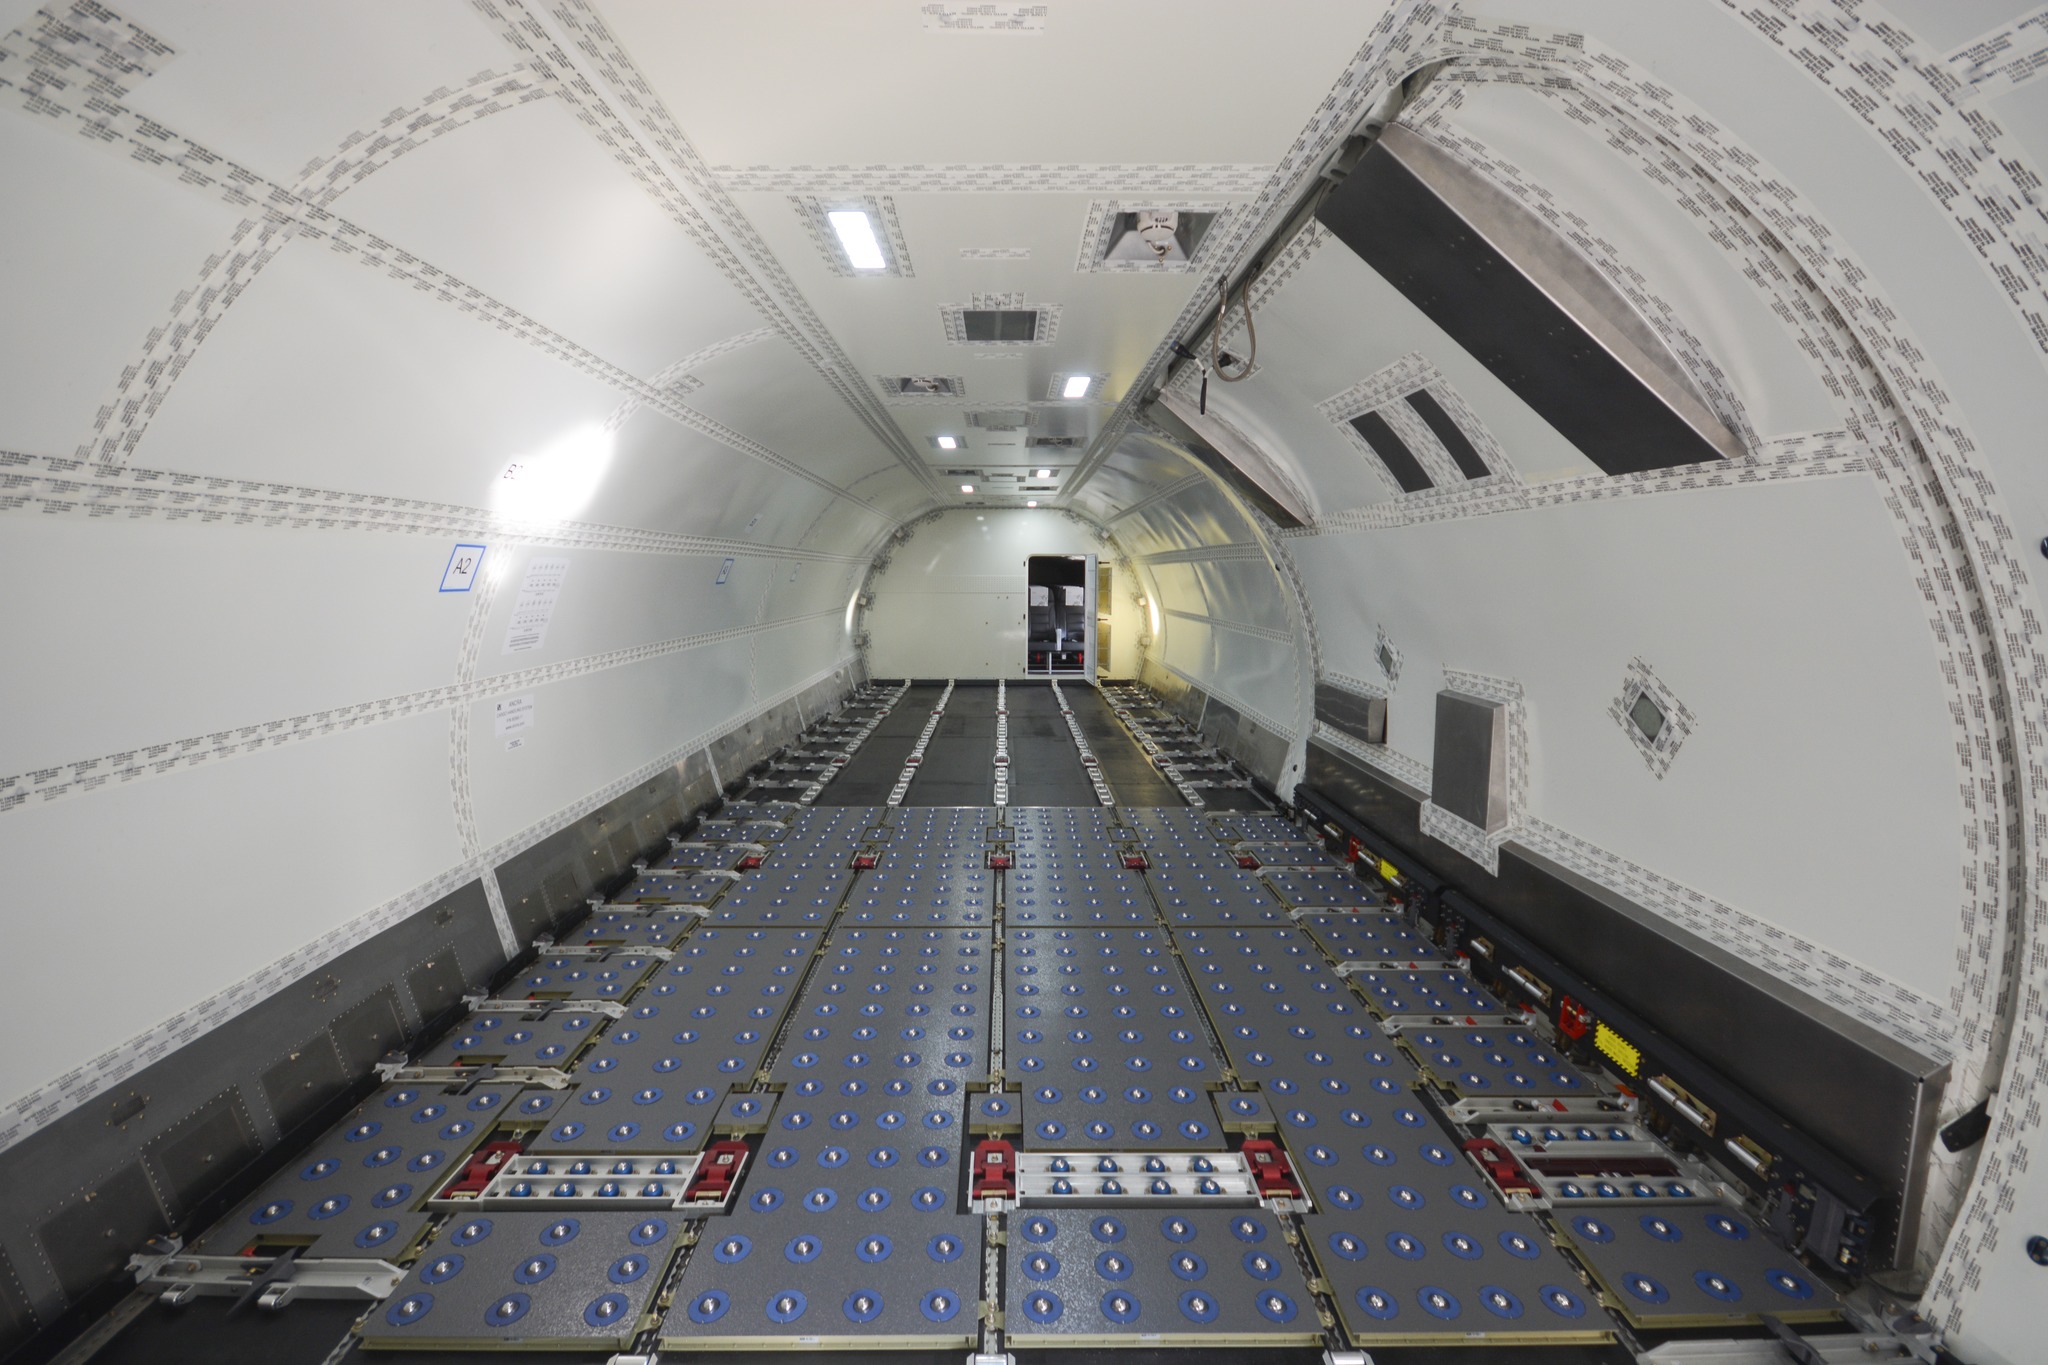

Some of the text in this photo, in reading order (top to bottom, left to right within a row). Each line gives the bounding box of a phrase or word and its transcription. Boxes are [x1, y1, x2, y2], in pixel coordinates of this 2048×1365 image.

[2018, 16, 2039, 30] NITTO
[1948, 42, 1985, 63] NITTO TAPE
[1986, 57, 2026, 78] NITTO TAPE
[452, 557, 472, 574] A2
